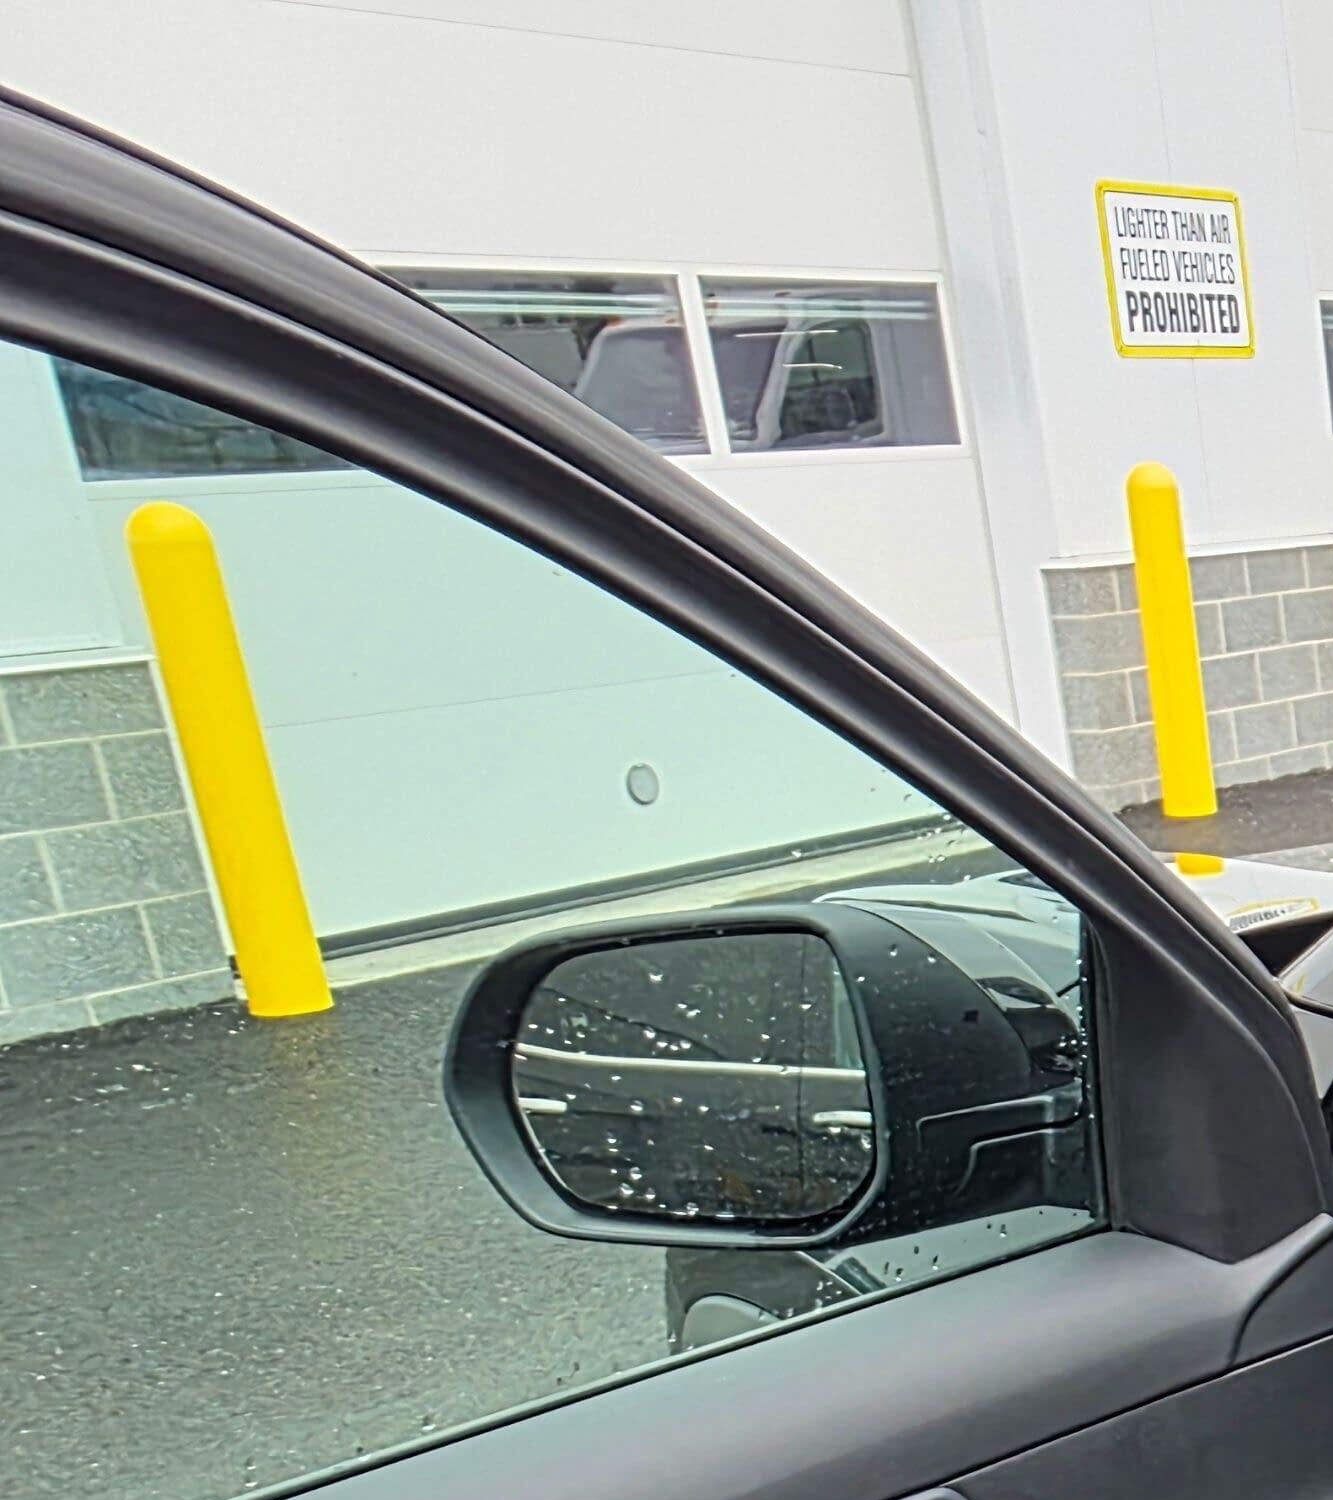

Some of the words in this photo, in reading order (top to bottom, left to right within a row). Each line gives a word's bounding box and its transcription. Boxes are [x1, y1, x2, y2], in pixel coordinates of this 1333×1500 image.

[1114, 206, 1169, 240] LIGHTER
[1171, 210, 1207, 243] THAN
[1210, 213, 1231, 244] AIR
[1120, 247, 1170, 282] FUELED
[1172, 250, 1236, 285] VEHICLES
[1125, 290, 1240, 334] PROHIBITED
